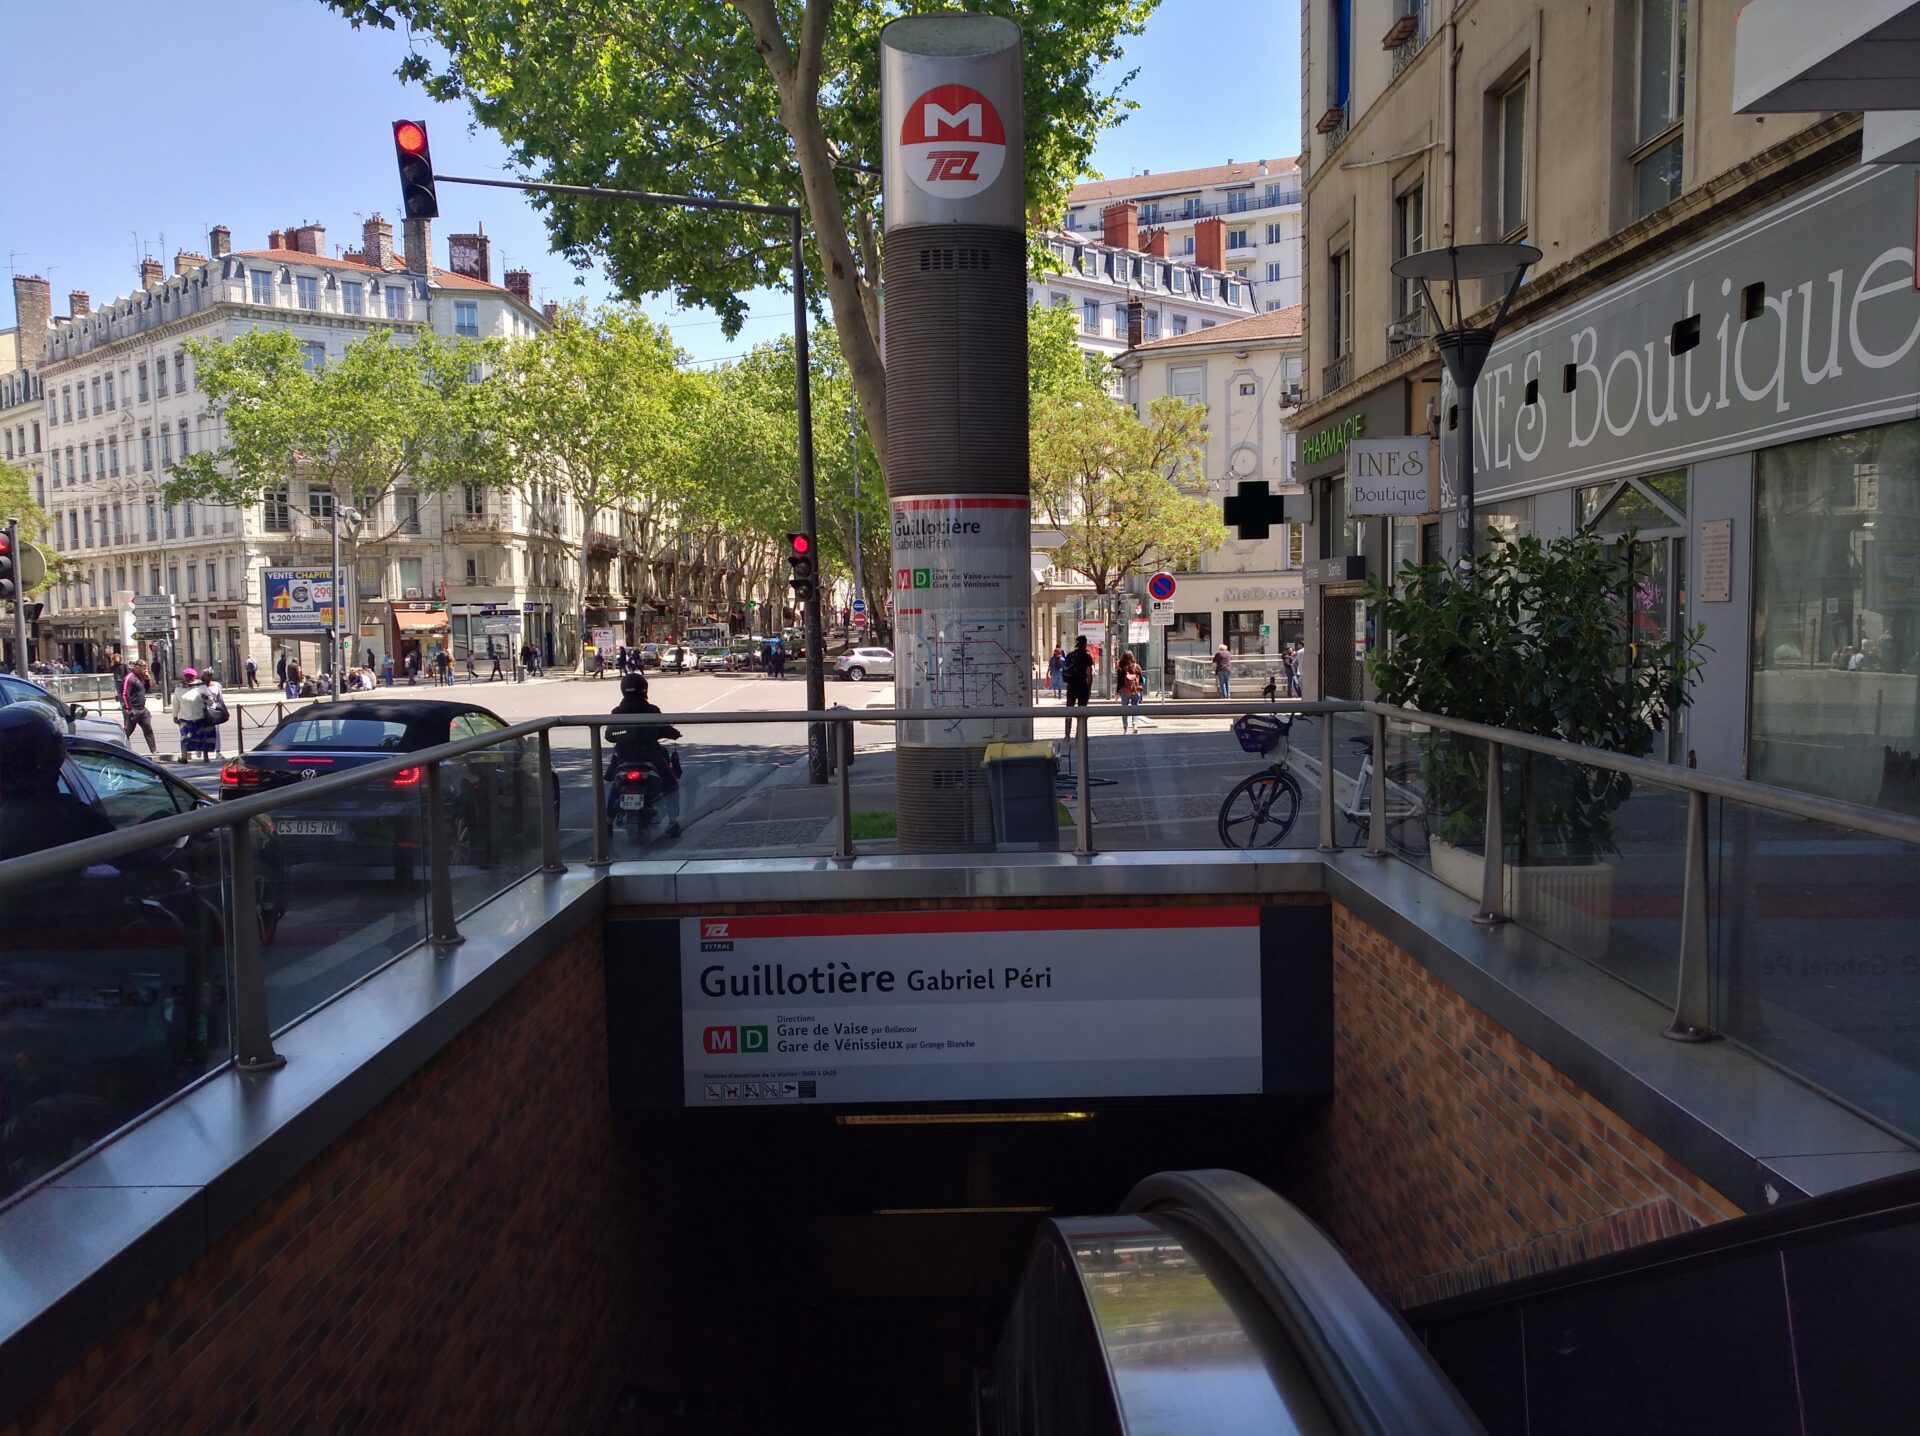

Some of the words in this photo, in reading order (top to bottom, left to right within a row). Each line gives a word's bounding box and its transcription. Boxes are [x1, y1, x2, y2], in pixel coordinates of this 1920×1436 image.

[924, 103, 982, 137] M
[926, 151, 979, 182] TCL
[1460, 350, 1547, 474] NES
[1567, 246, 1920, 448] Boutique
[1302, 414, 1361, 466] PHARMACIE
[1357, 450, 1424, 477] INES
[1354, 486, 1427, 506] Boutique
[894, 518, 981, 537] Guillotière
[267, 572, 294, 580] VENTE
[899, 572, 909, 586] M
[915, 571, 927, 586] D
[963, 572, 982, 580] Vaise
[963, 580, 1001, 588] Vénissieux
[277, 614, 292, 622] 200
[704, 923, 729, 937] TCL
[700, 962, 895, 997] Guillotière
[907, 968, 995, 992] Gabriel
[1004, 966, 1052, 989] Péri
[777, 1015, 815, 1023] Directions
[777, 1024, 808, 1037] Gare
[813, 1024, 829, 1036] de
[834, 1022, 868, 1035] Vaise
[871, 1027, 883, 1036] par
[884, 1025, 919, 1034] Bellecour
[710, 1030, 732, 1050] M
[746, 1029, 763, 1049] D
[777, 1040, 809, 1053] Gare
[813, 1039, 830, 1051] de
[834, 1038, 903, 1051] Vénissieux
[906, 1042, 918, 1051] par
[919, 1041, 945, 1051] Grange
[946, 1040, 976, 1049] Blanche
